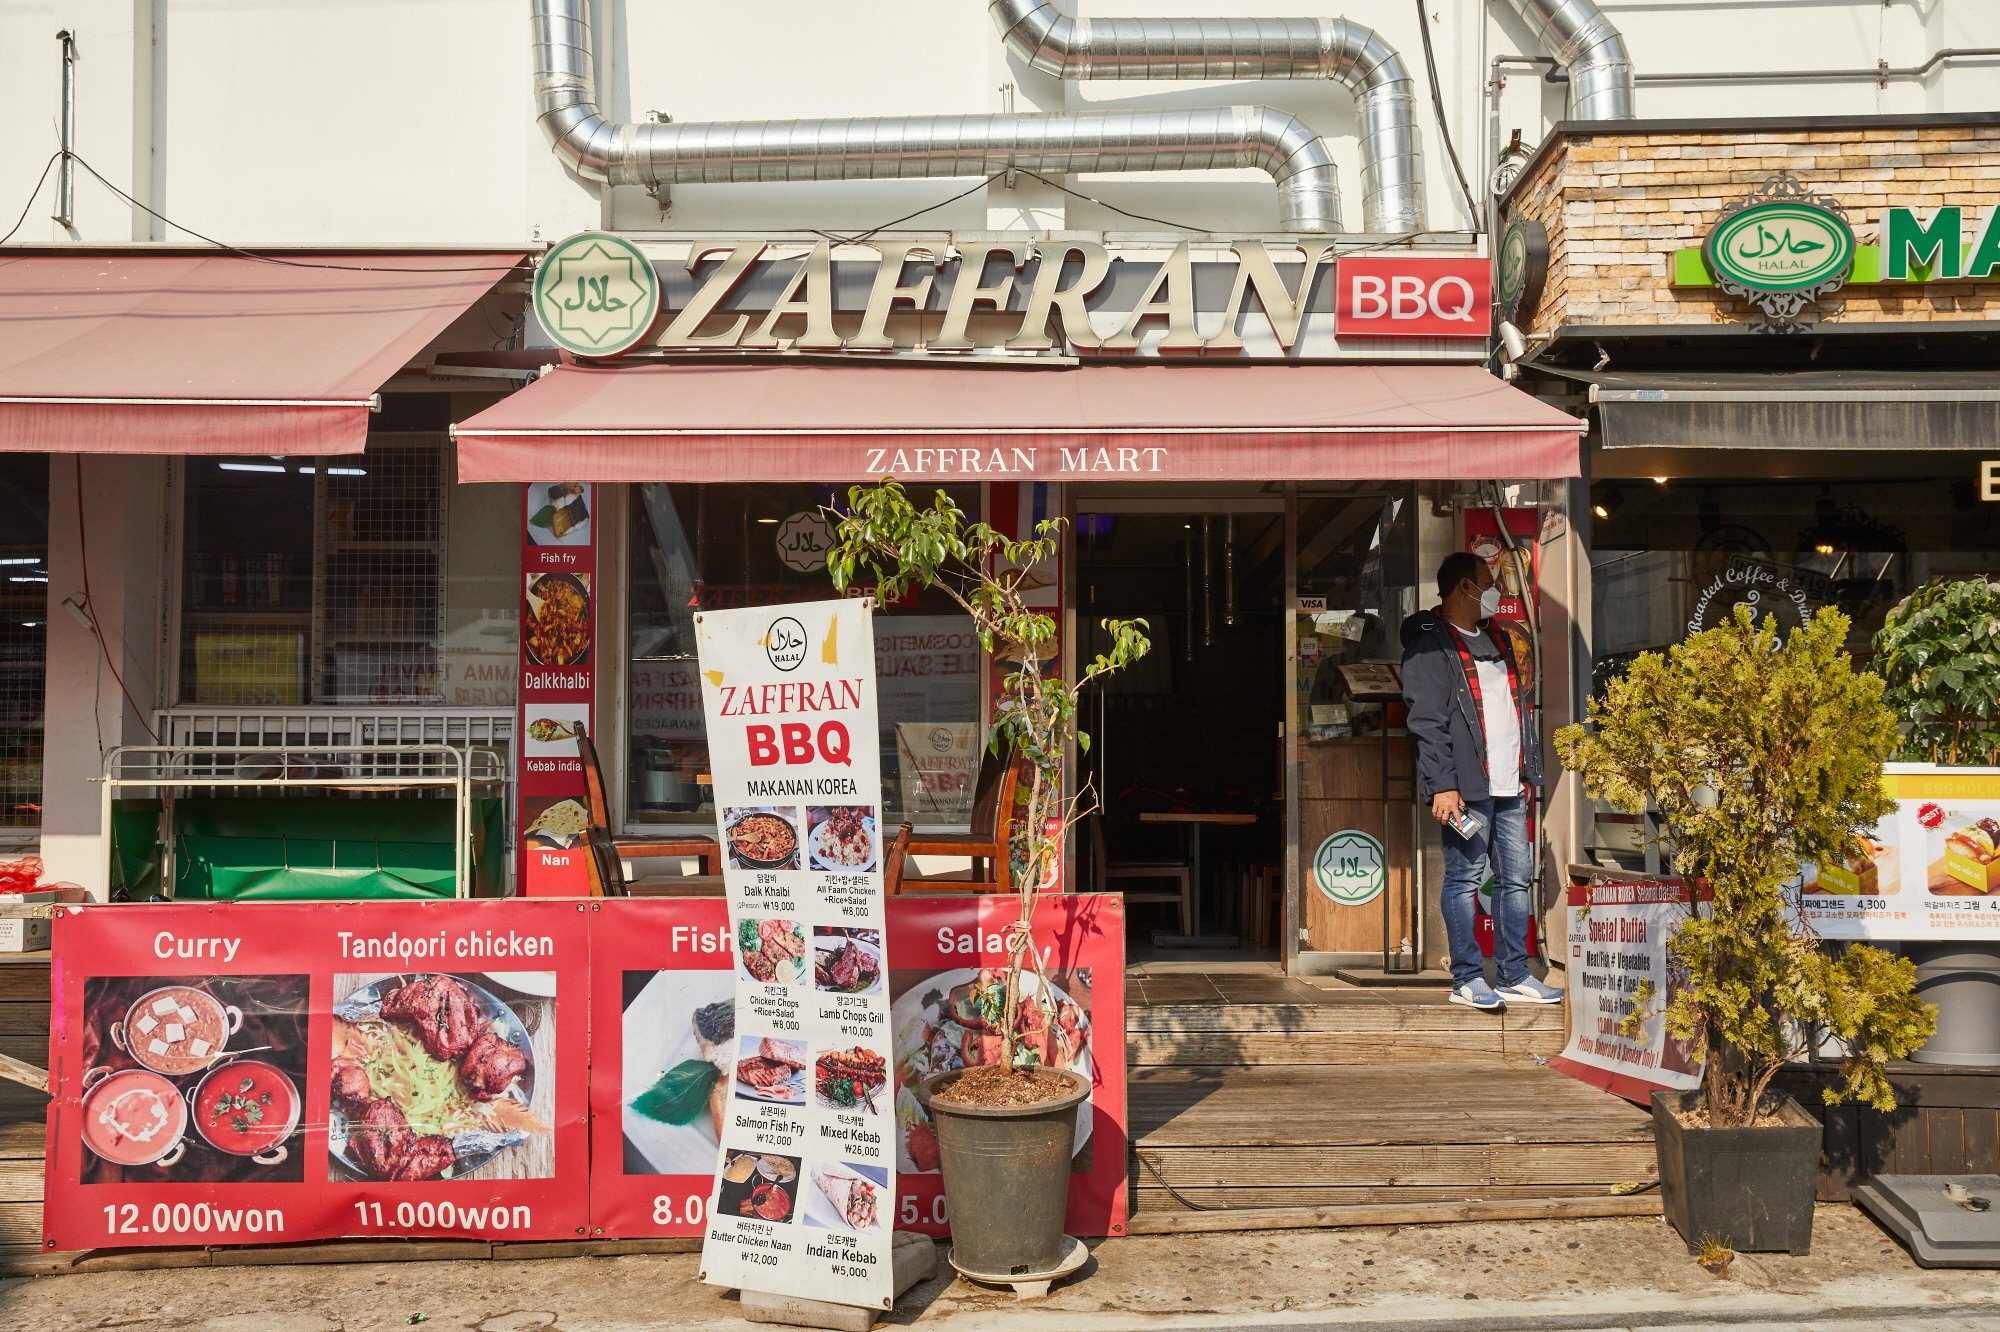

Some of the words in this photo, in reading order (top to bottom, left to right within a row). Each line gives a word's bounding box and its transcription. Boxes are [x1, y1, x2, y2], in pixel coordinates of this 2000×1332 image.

[1739, 224, 1826, 258] حلال
[1758, 259, 1809, 271] HALAL
[564, 274, 629, 313] حلال
[655, 238, 1337, 351] ZAFFRAN
[1351, 275, 1476, 323] BBQ
[865, 447, 1037, 474] ZAFFRAN
[1059, 447, 1168, 473] MART
[787, 531, 824, 553] حلال
[540, 553, 560, 564] Fish
[562, 553, 577, 565] fry
[1726, 565, 1774, 584] Coffee
[1776, 577, 1790, 592] &
[1301, 599, 1323, 609] VISA
[1495, 602, 1517, 614] assi
[770, 628, 803, 651] حلال
[774, 653, 801, 663] HALAL
[525, 672, 590, 690] Dalkkhalbi
[719, 678, 864, 717] ZAFFRAN
[745, 720, 853, 768] BBQ
[527, 760, 556, 772] Kebab
[558, 760, 583, 772] india
[747, 779, 814, 797] MAKANAN
[817, 778, 858, 796] KOREA
[1920, 807, 1941, 823] BEST
[541, 854, 570, 866] Nan
[756, 873, 777, 884] 닭갈비
[744, 885, 763, 897] Dalk
[765, 885, 790, 898] Khalbi
[816, 885, 827, 895] All
[828, 885, 848, 895] Faam
[849, 886, 877, 896] Chicken
[824, 896, 867, 906] +Rice+Salad
[1857, 899, 1886, 910] 4,300
[1963, 900, 1980, 910] 그릴
[1588, 917, 1617, 944] Special
[1620, 917, 1647, 944] Buffet
[153, 931, 241, 963] Curry
[337, 930, 447, 961] Tandoori
[454, 930, 554, 958] chicken
[671, 926, 734, 954] Fish
[1586, 950, 1610, 969] Meat/Fish
[1617, 951, 1651, 972] Vegetables
[764, 985, 789, 998] 치킨그릴
[749, 995, 776, 1007] Chicken
[777, 997, 800, 1009] Chops
[836, 996, 868, 1009] 양고기그릴
[753, 1007, 795, 1019] +Rice+Salad
[819, 1009, 842, 1021] Lamb
[842, 1010, 868, 1023] Chops
[868, 1012, 884, 1024] Grill
[759, 1105, 787, 1117] 살몬피쉬
[735, 1115, 769, 1130] Salmon
[770, 1119, 790, 1132] Fish
[790, 1121, 805, 1138] Fry
[820, 1125, 848, 1141] Mixed
[850, 1129, 881, 1144] Kebab
[102, 1202, 285, 1235] 12.000won
[354, 1200, 532, 1230] 11.000won
[736, 1221, 765, 1235] 버터치킨
[765, 1225, 774, 1237] 난
[711, 1230, 736, 1243] Butter
[736, 1234, 769, 1248] Chicken
[770, 1239, 792, 1252] Naan
[806, 1243, 839, 1260] Indian
[841, 1248, 877, 1265] Kebab
